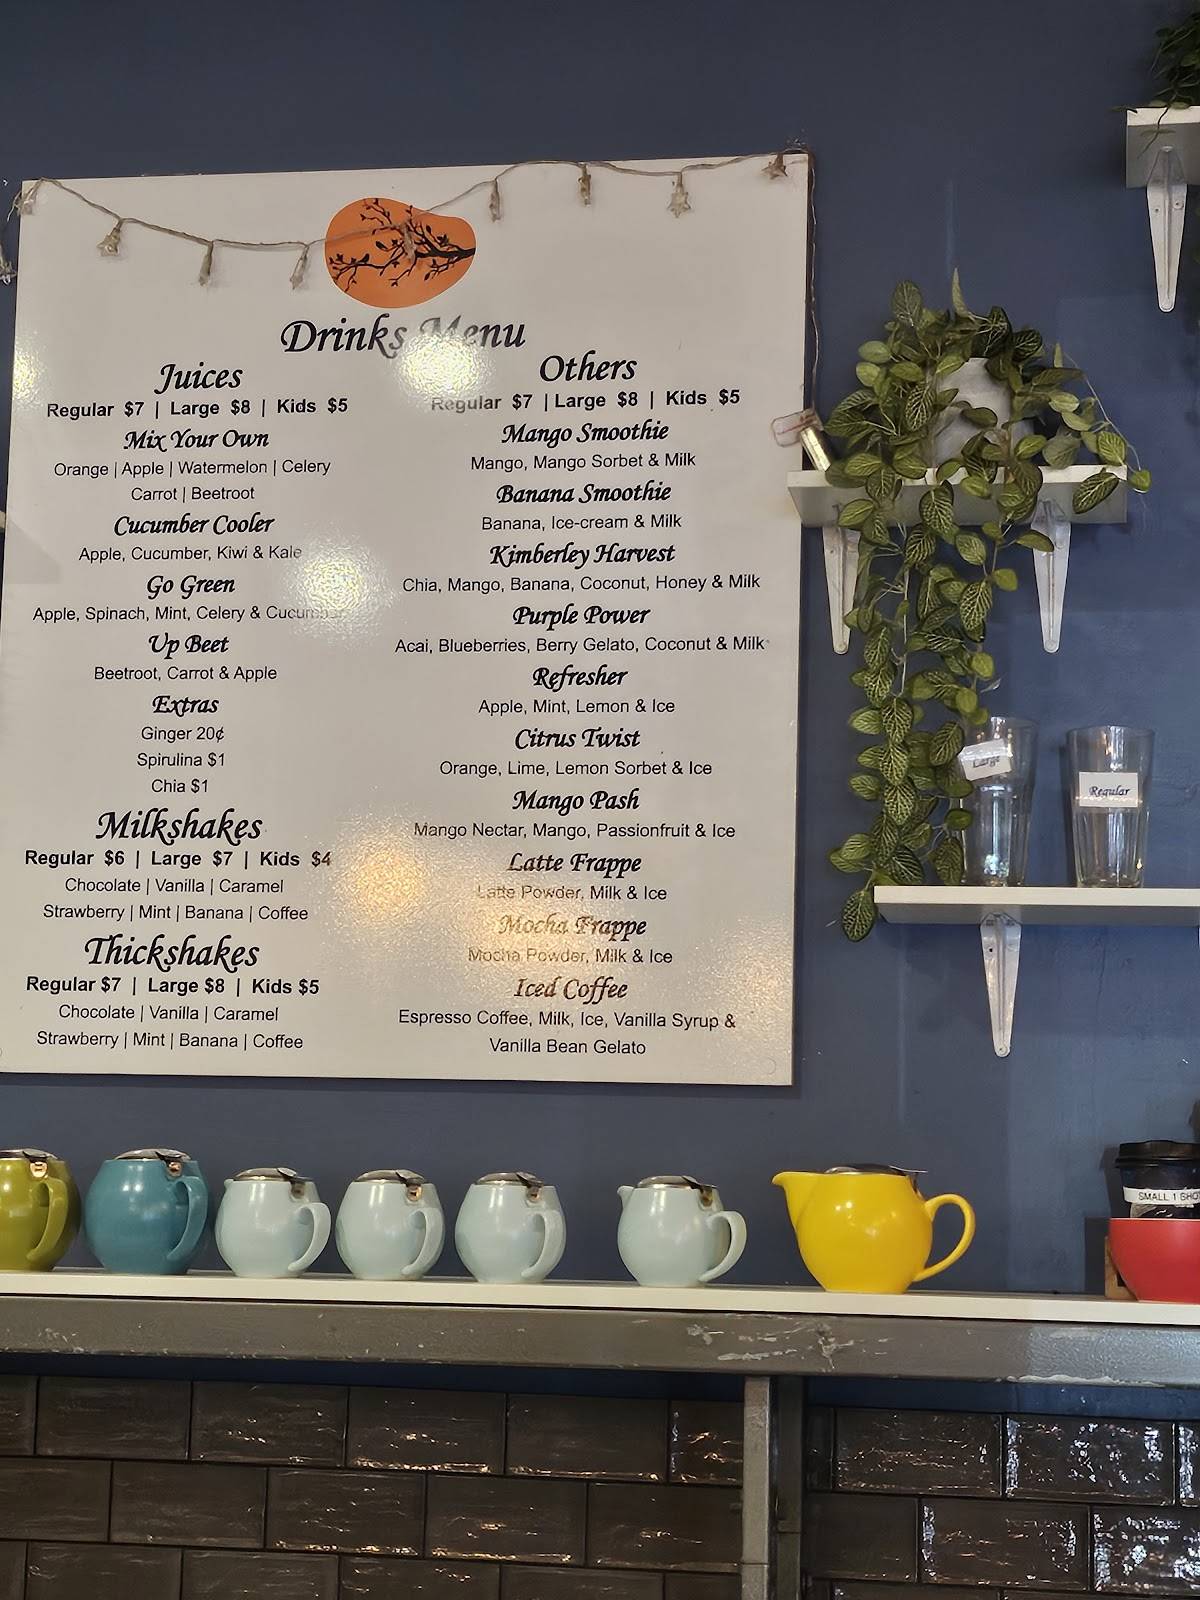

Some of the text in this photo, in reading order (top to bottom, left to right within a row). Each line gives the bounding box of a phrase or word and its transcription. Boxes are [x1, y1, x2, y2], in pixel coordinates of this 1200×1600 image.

[280, 313, 407, 359] Drinks
[539, 350, 638, 382] Others
[153, 361, 243, 395] Juices
[47, 397, 348, 421] Regular $7 Large $8 Kids $5
[432, 388, 740, 414] Regular $7 Large $8 Kids $5
[123, 428, 269, 453] Mix Your Own
[501, 418, 669, 447] Mango Smoothie
[54, 459, 331, 479] Orange Apple Watermelon Celery
[471, 452, 696, 472] Mango, Mango Sorbet Milk
[131, 486, 255, 501] Carrot Beetroot
[496, 480, 672, 504] Banana Smoothie
[114, 511, 276, 536] Cucumber Cooler
[482, 514, 682, 532] Banana, Ice-cream Milk
[78, 545, 302, 563] Apple, Cucumber, Kiwi Kale
[490, 542, 676, 569] Kimberley Harvest
[147, 575, 236, 600] Go Green
[403, 574, 761, 594] Chia, Mango, Banana, Coconut, Honey Milk
[32, 607, 80, 624] Apple,
[85, 606, 149, 623] Spinach,
[155, 606, 190, 621] Mint,
[196, 605, 245, 623] Celery
[512, 604, 651, 631] Purple Power
[148, 632, 230, 659] Up Beet
[394, 636, 765, 655] Acai, Blueberries, Berry Gelato, Coconut Milk
[94, 666, 277, 682] Beetroot, Carrot Apple
[532, 665, 629, 692] Refresher
[152, 695, 219, 717] Extras
[478, 698, 675, 716] Apple, Mint, Lemon Ice
[141, 726, 224, 744] Ginger 20¢
[515, 727, 641, 750] Citrus Twist
[137, 752, 224, 770] Spirulina $1
[440, 760, 712, 779] Orange, Lime, Lemon Sorbet Ice
[151, 778, 208, 794] Chia $1
[512, 788, 640, 816] Mango Pash
[95, 807, 263, 846] Milkshakes
[414, 822, 736, 840] Mango Nectar, Mango, Passionfruit Ice
[25, 849, 332, 869] Regular $6 Large $7 Kids $4
[506, 852, 642, 879] Latte Frappe
[65, 877, 284, 893] Chocolate Vanilla Caramel
[521, 885, 584, 902] Powder,
[590, 885, 622, 900] Milk
[644, 885, 667, 900] Ice
[43, 904, 308, 922] Strawberry Mint Banana Coffee
[498, 914, 647, 942] Mocha Frappe
[84, 933, 260, 973] Thickshakes
[526, 948, 589, 964] Powder,
[596, 948, 627, 963] Milk
[650, 949, 673, 964] Ice
[26, 976, 319, 996] Regular $7 Large $8 Kids $5
[513, 977, 628, 1004] Iced Coffee
[59, 1004, 279, 1021] Chocolate Vanilla Caramel
[399, 1009, 719, 1030] Espresso Coffee, Milk, Ice, Vanilla Syrup
[37, 1030, 303, 1049] Strawberry Mint Banana Coffee
[489, 1037, 646, 1055] Vanilla Bean Gelato
[1138, 1191, 1168, 1201] SMALL
[1180, 1192, 1200, 1201] SHO
